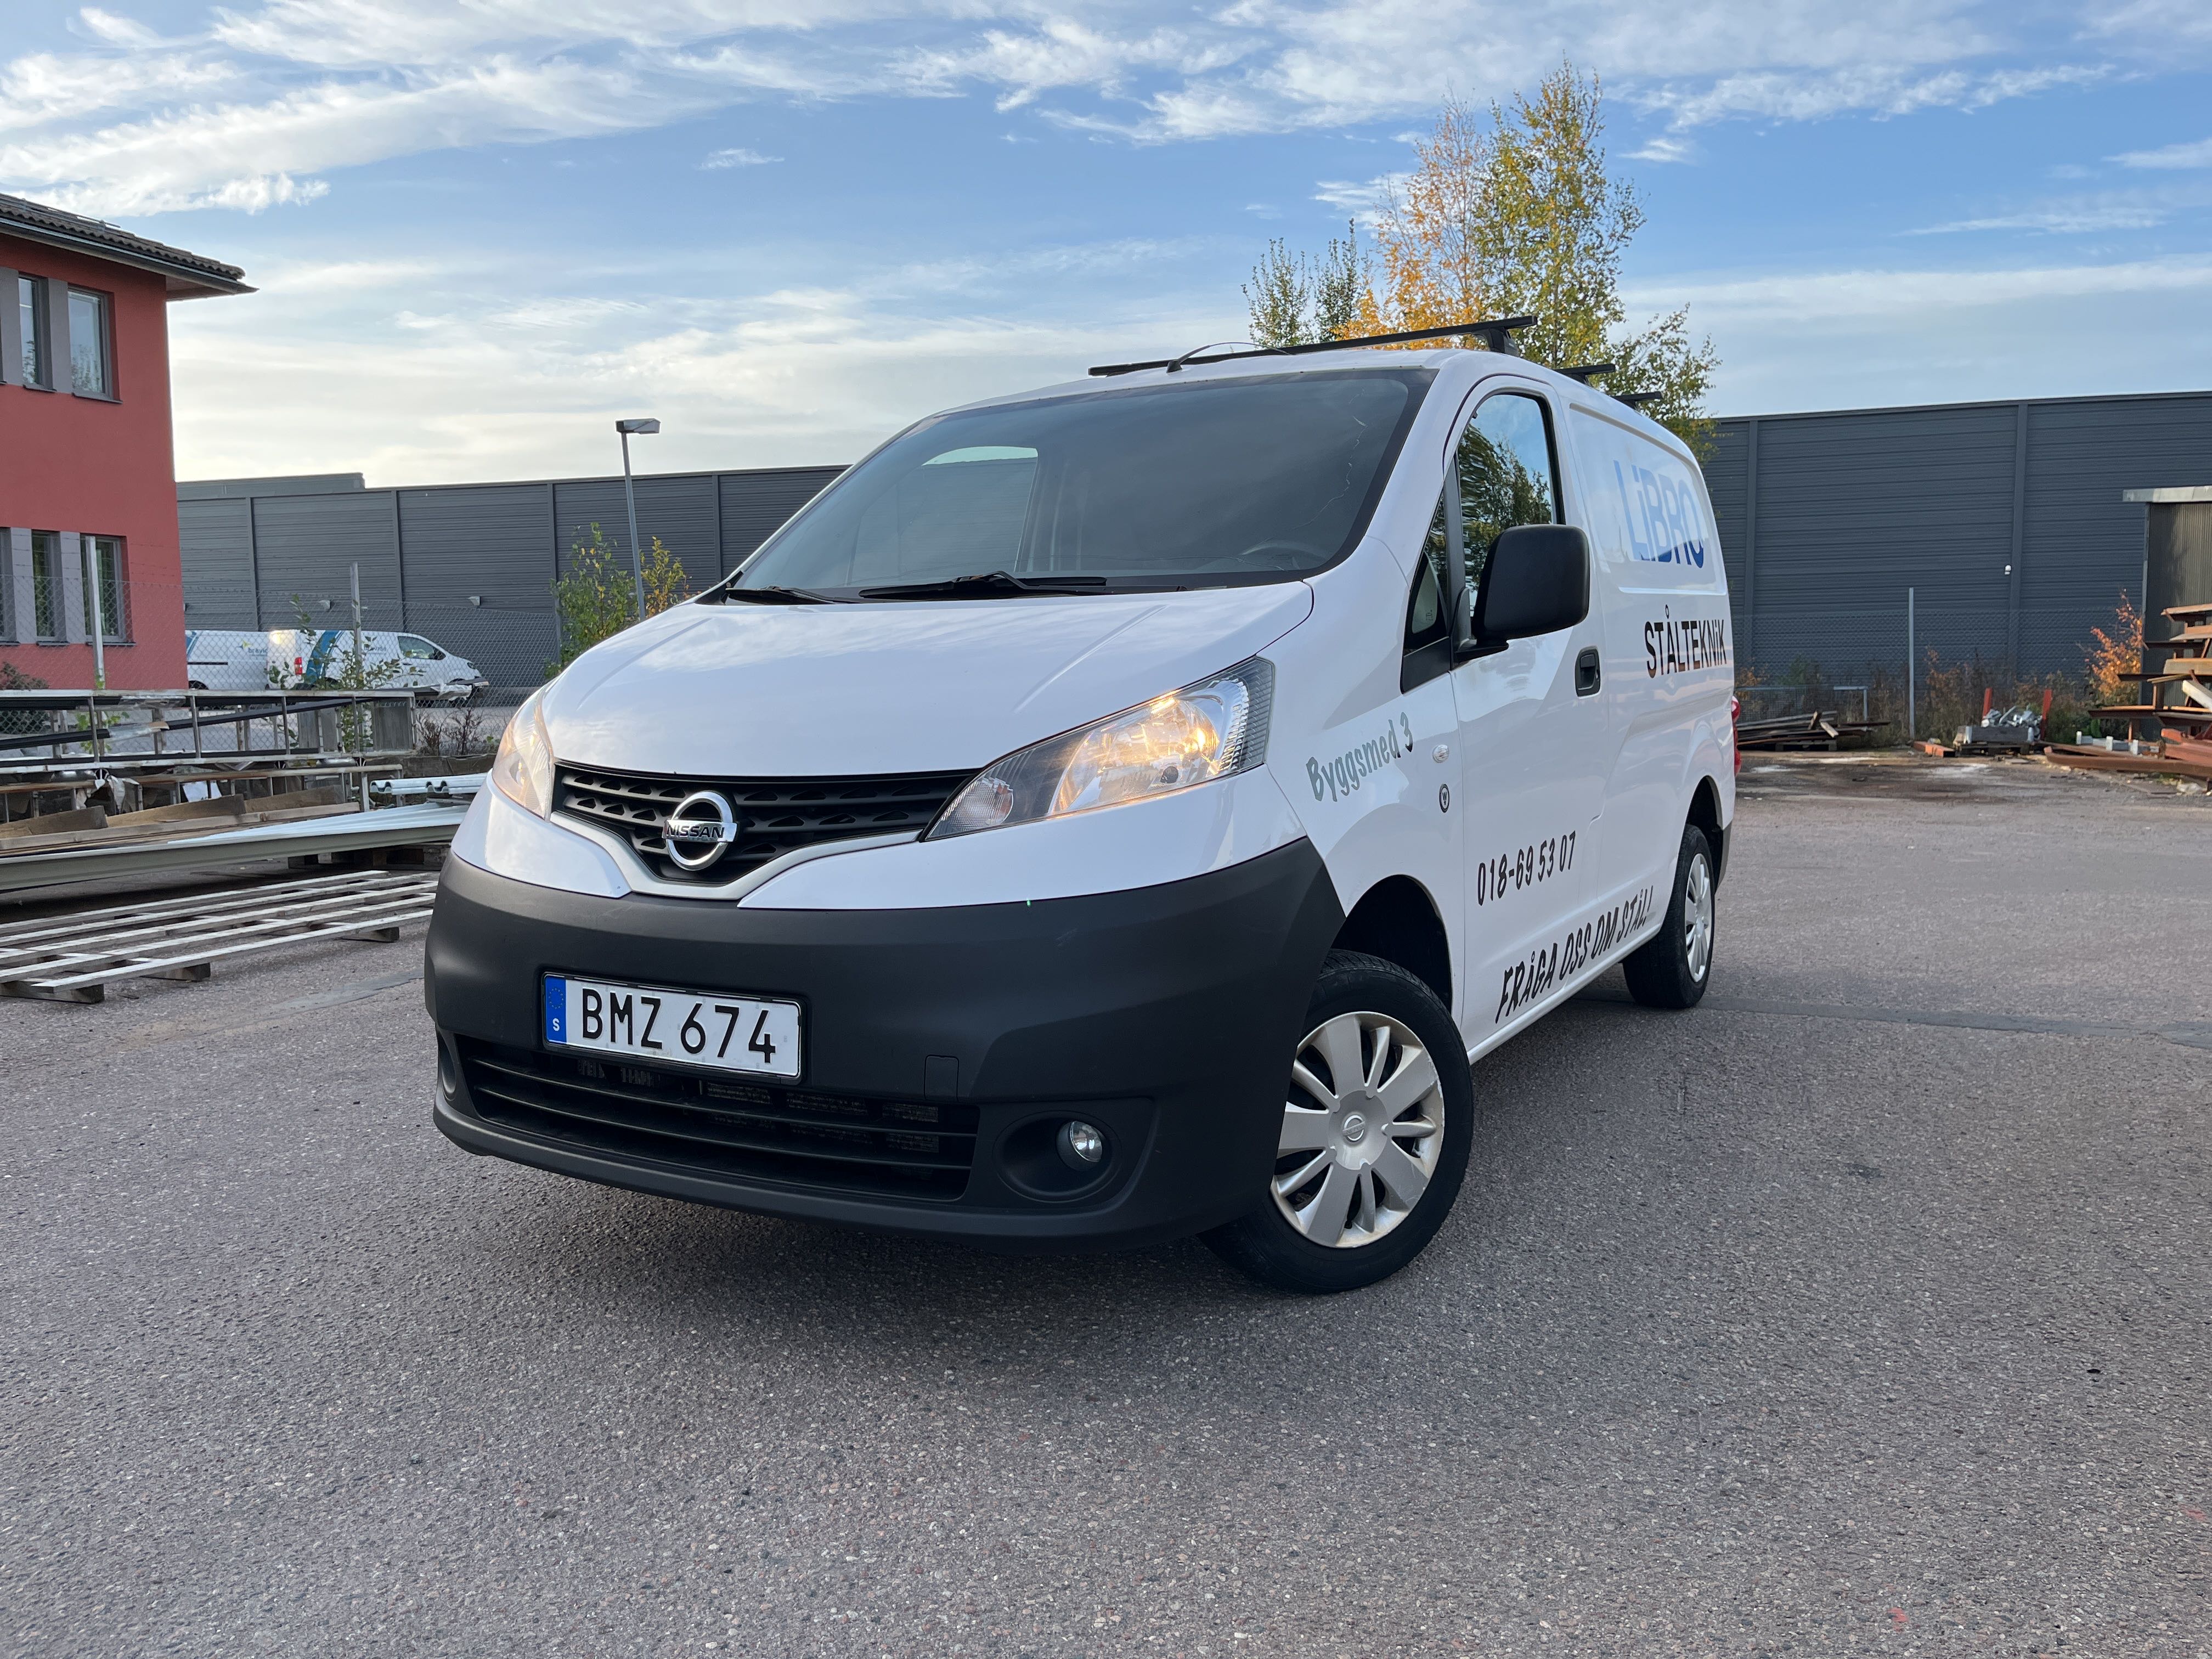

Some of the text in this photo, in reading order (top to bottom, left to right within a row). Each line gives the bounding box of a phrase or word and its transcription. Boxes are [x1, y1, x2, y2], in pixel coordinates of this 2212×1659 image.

[1306, 712, 1413, 802] Byggsmed 3
[667, 825, 725, 838] NISSAN
[1478, 830, 1576, 906] 018-69 53 07
[1495, 885, 1654, 1024] FRÅGA OSS OM STÅL!
[552, 988, 776, 1063] S BMZ 674
